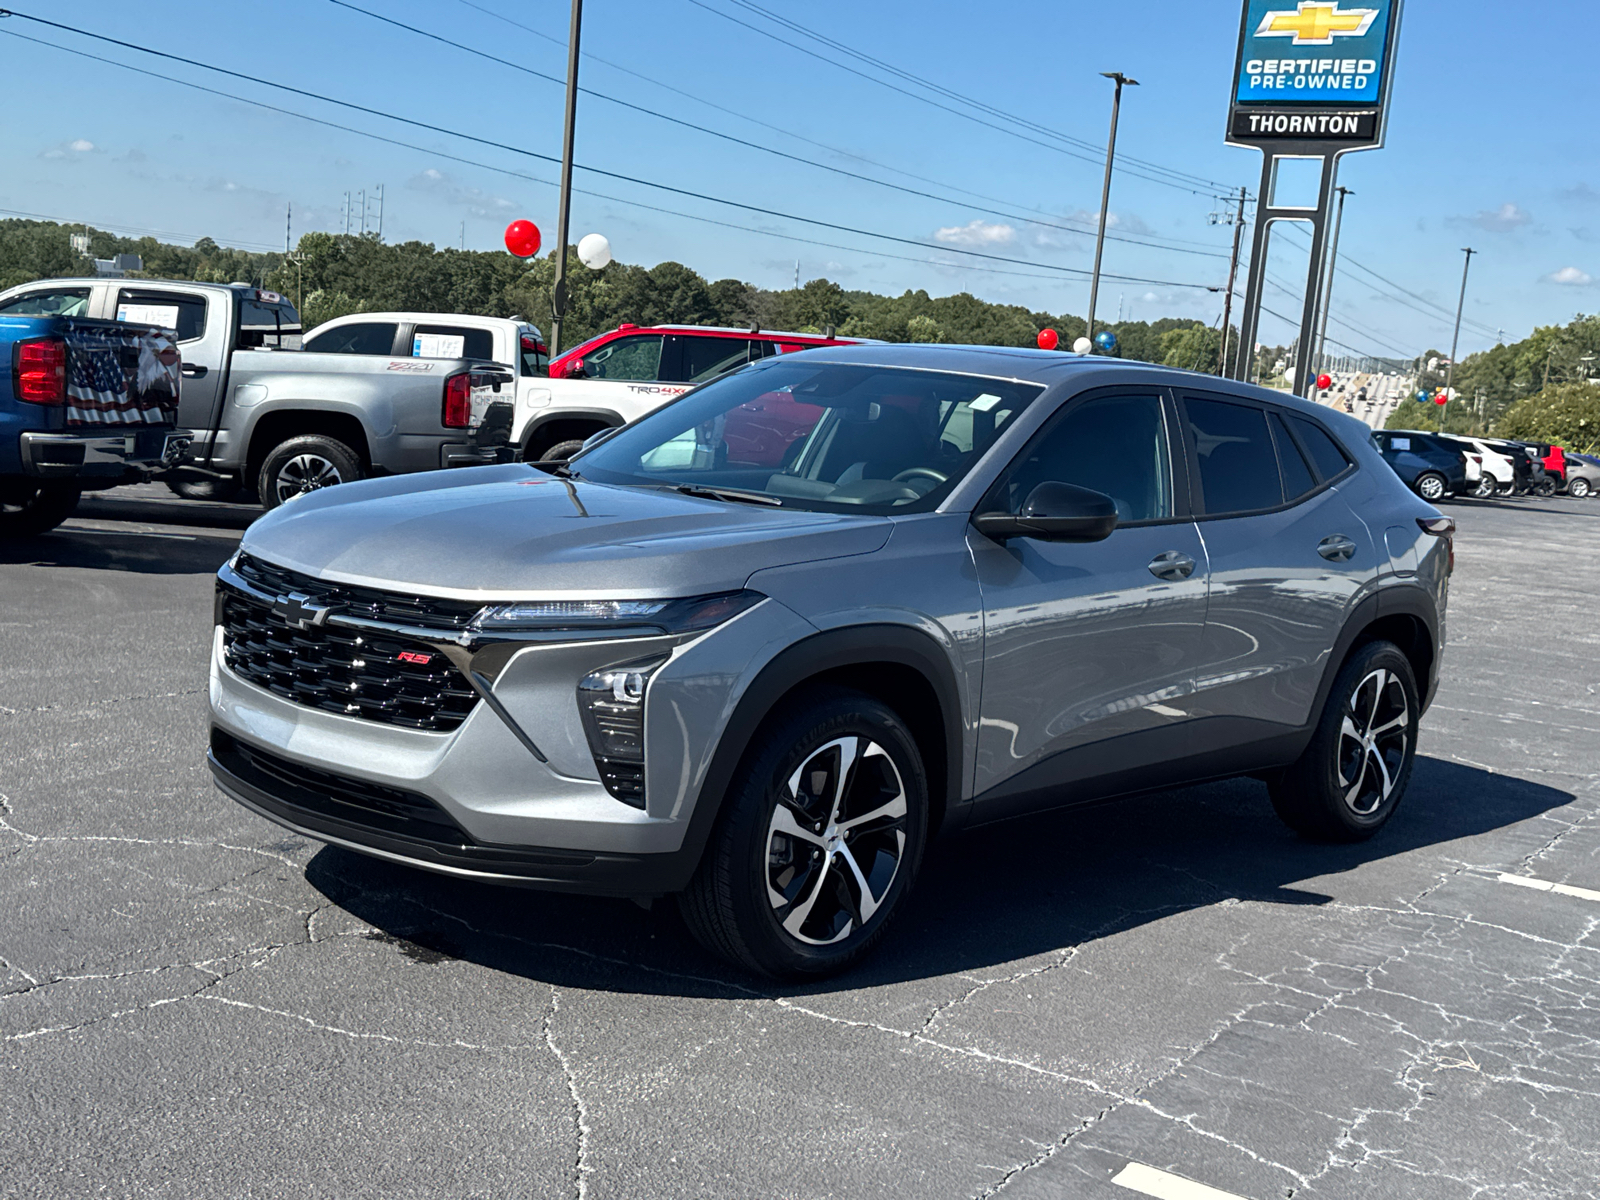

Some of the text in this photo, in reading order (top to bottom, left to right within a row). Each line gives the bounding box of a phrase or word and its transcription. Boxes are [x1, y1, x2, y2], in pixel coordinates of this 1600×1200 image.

[1246, 59, 1376, 74] CERTIFIED
[1250, 75, 1367, 89] PRE-OWNED
[1249, 115, 1358, 133] THORNTON
[397, 651, 431, 664] RS
